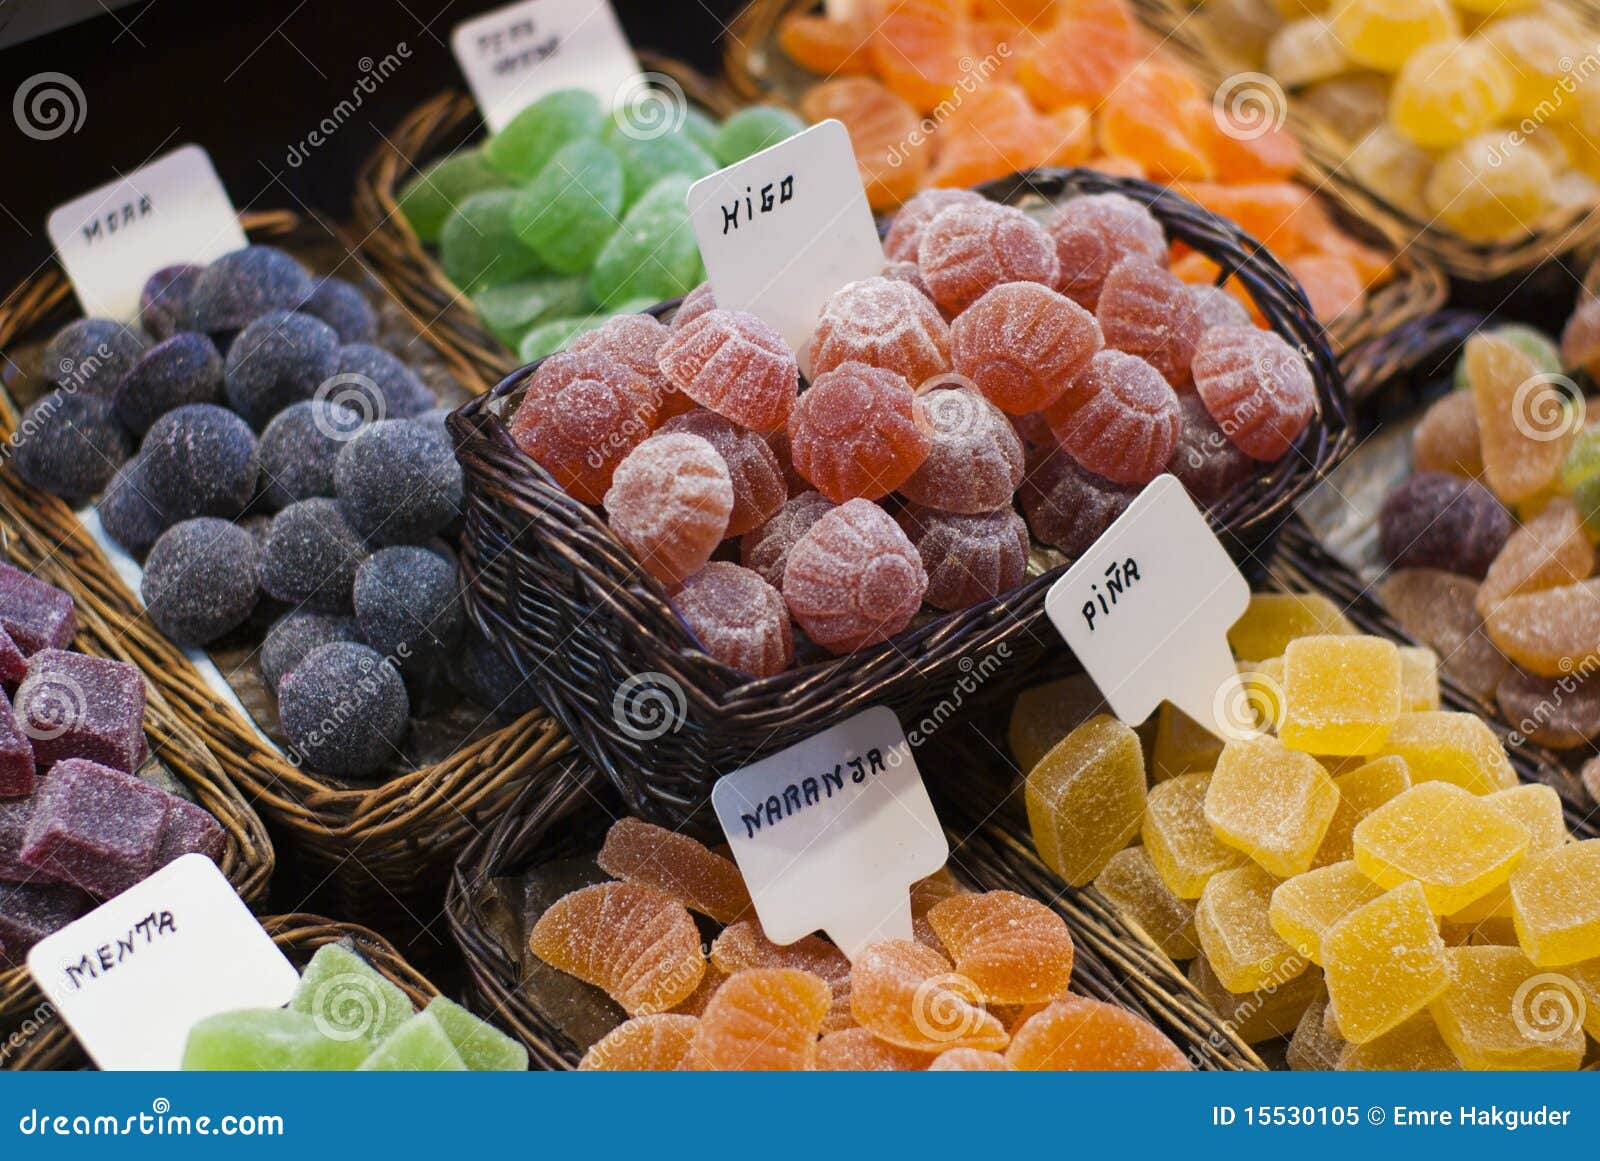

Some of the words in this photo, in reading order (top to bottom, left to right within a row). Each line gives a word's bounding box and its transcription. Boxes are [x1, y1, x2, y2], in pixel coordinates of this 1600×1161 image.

[82, 193, 153, 247] MORA
[741, 747, 886, 839] NARANJA
[65, 909, 178, 989] MENTA
